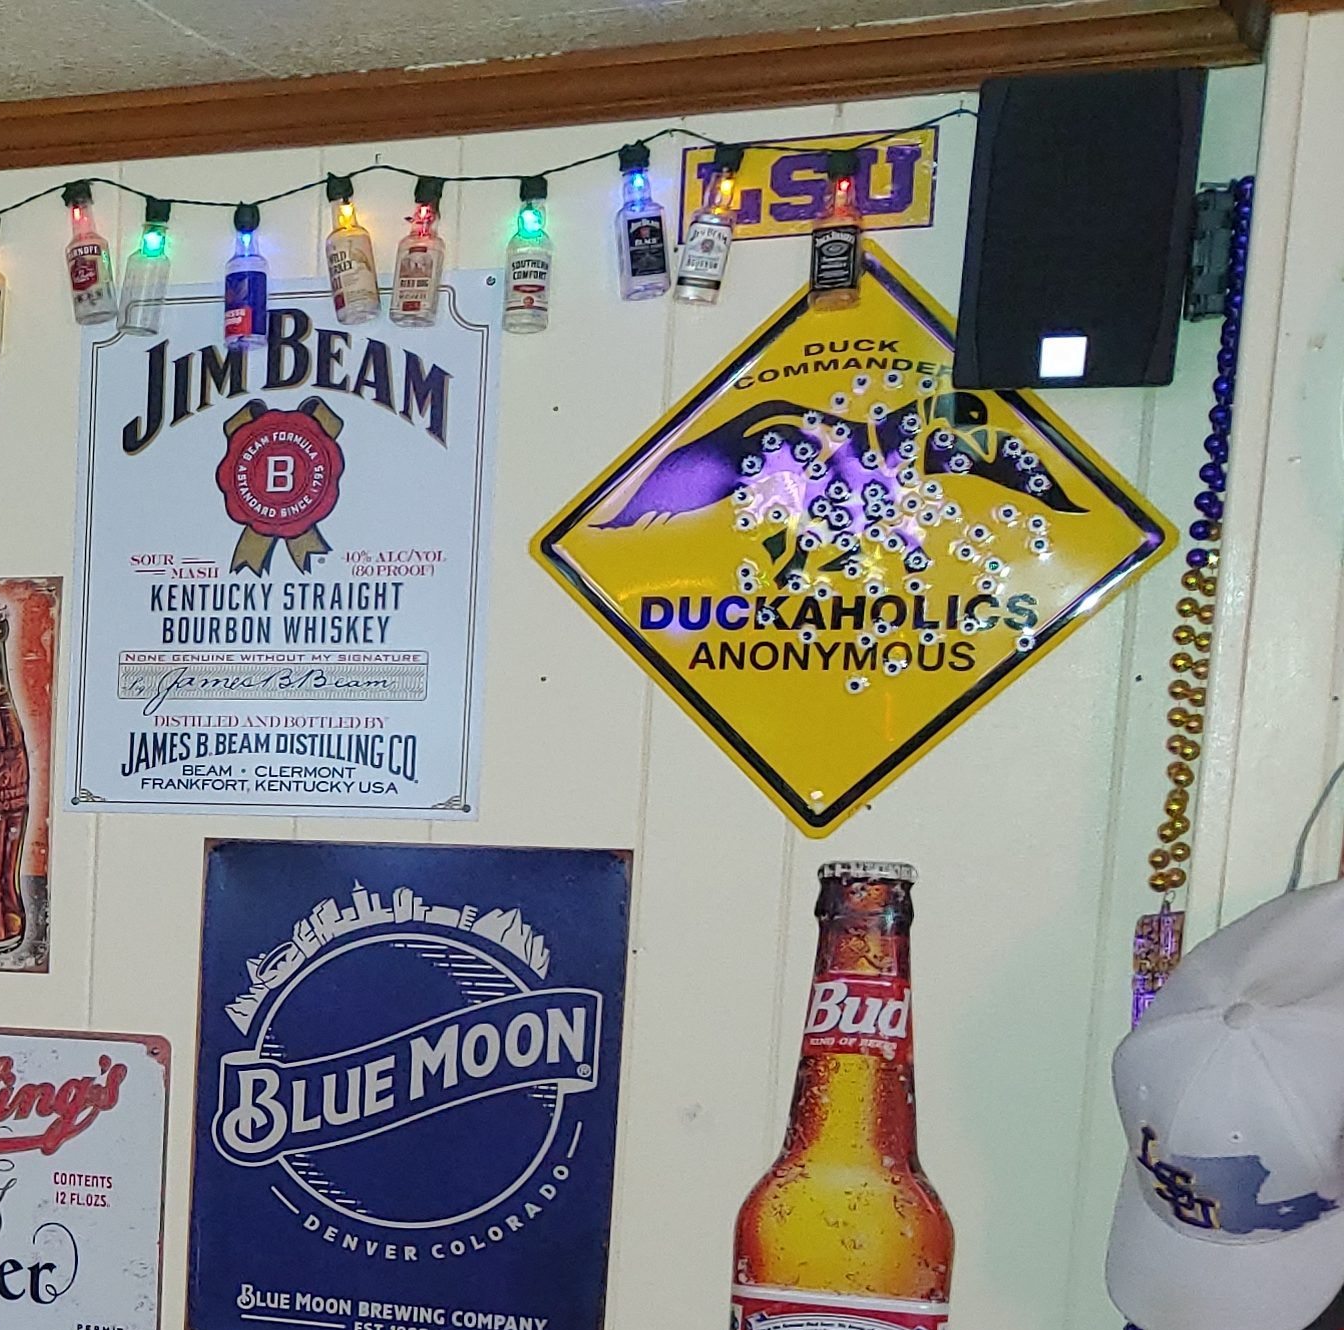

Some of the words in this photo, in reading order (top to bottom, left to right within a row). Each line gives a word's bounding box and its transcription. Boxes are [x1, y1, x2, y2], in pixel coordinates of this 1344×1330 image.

[512, 268, 548, 281] COMFORT
[803, 339, 901, 357] DUCK
[262, 308, 453, 451] BEAM
[273, 432, 318, 460] FORMULA
[266, 456, 295, 492] B
[151, 583, 273, 612] KENTUCKY
[284, 582, 404, 611] STRAIGHT
[639, 592, 1040, 632] DUCKAHOLICS
[162, 616, 271, 644] BOURBON
[284, 616, 391, 644] WHISKEY
[688, 640, 977, 673] ANONYMOUS
[121, 732, 191, 777] JAMES
[215, 732, 271, 756] BEAM
[275, 733, 383, 769] DISTILLING
[182, 764, 232, 776] BEAM
[254, 766, 356, 779] CLERMONT
[255, 779, 355, 794] KENTUCKY
[804, 981, 911, 1039] Bud
[409, 1007, 587, 1102] MOON
[53, 1171, 113, 1189] CONTENTS
[295, 1293, 352, 1316] MOON
[358, 1301, 446, 1326] BREWING
